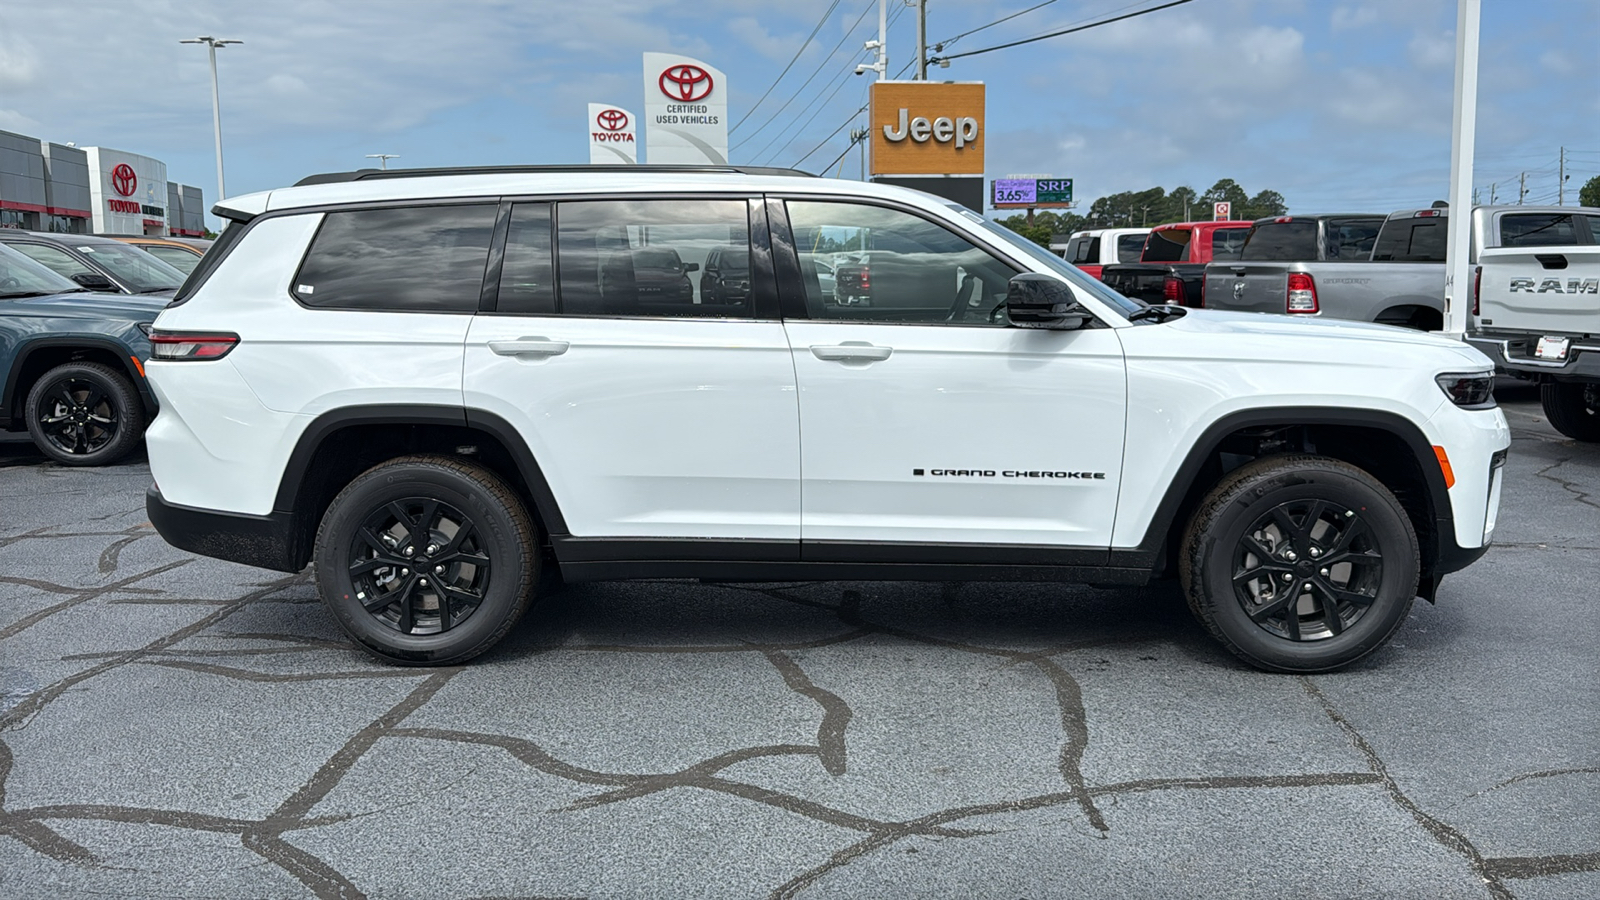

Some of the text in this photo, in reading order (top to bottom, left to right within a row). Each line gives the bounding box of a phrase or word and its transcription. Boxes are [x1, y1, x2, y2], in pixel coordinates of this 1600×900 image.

[667, 105, 707, 114] CERTIFIED
[656, 116, 718, 124] USED VEHICLES
[883, 108, 978, 148] Jeep
[592, 132, 634, 142] TOYOTA
[1038, 181, 1071, 191] SRP
[108, 199, 141, 214] TOYOTA
[1510, 277, 1599, 294] RAM
[930, 469, 1106, 480] GRAND CHEROKEE
